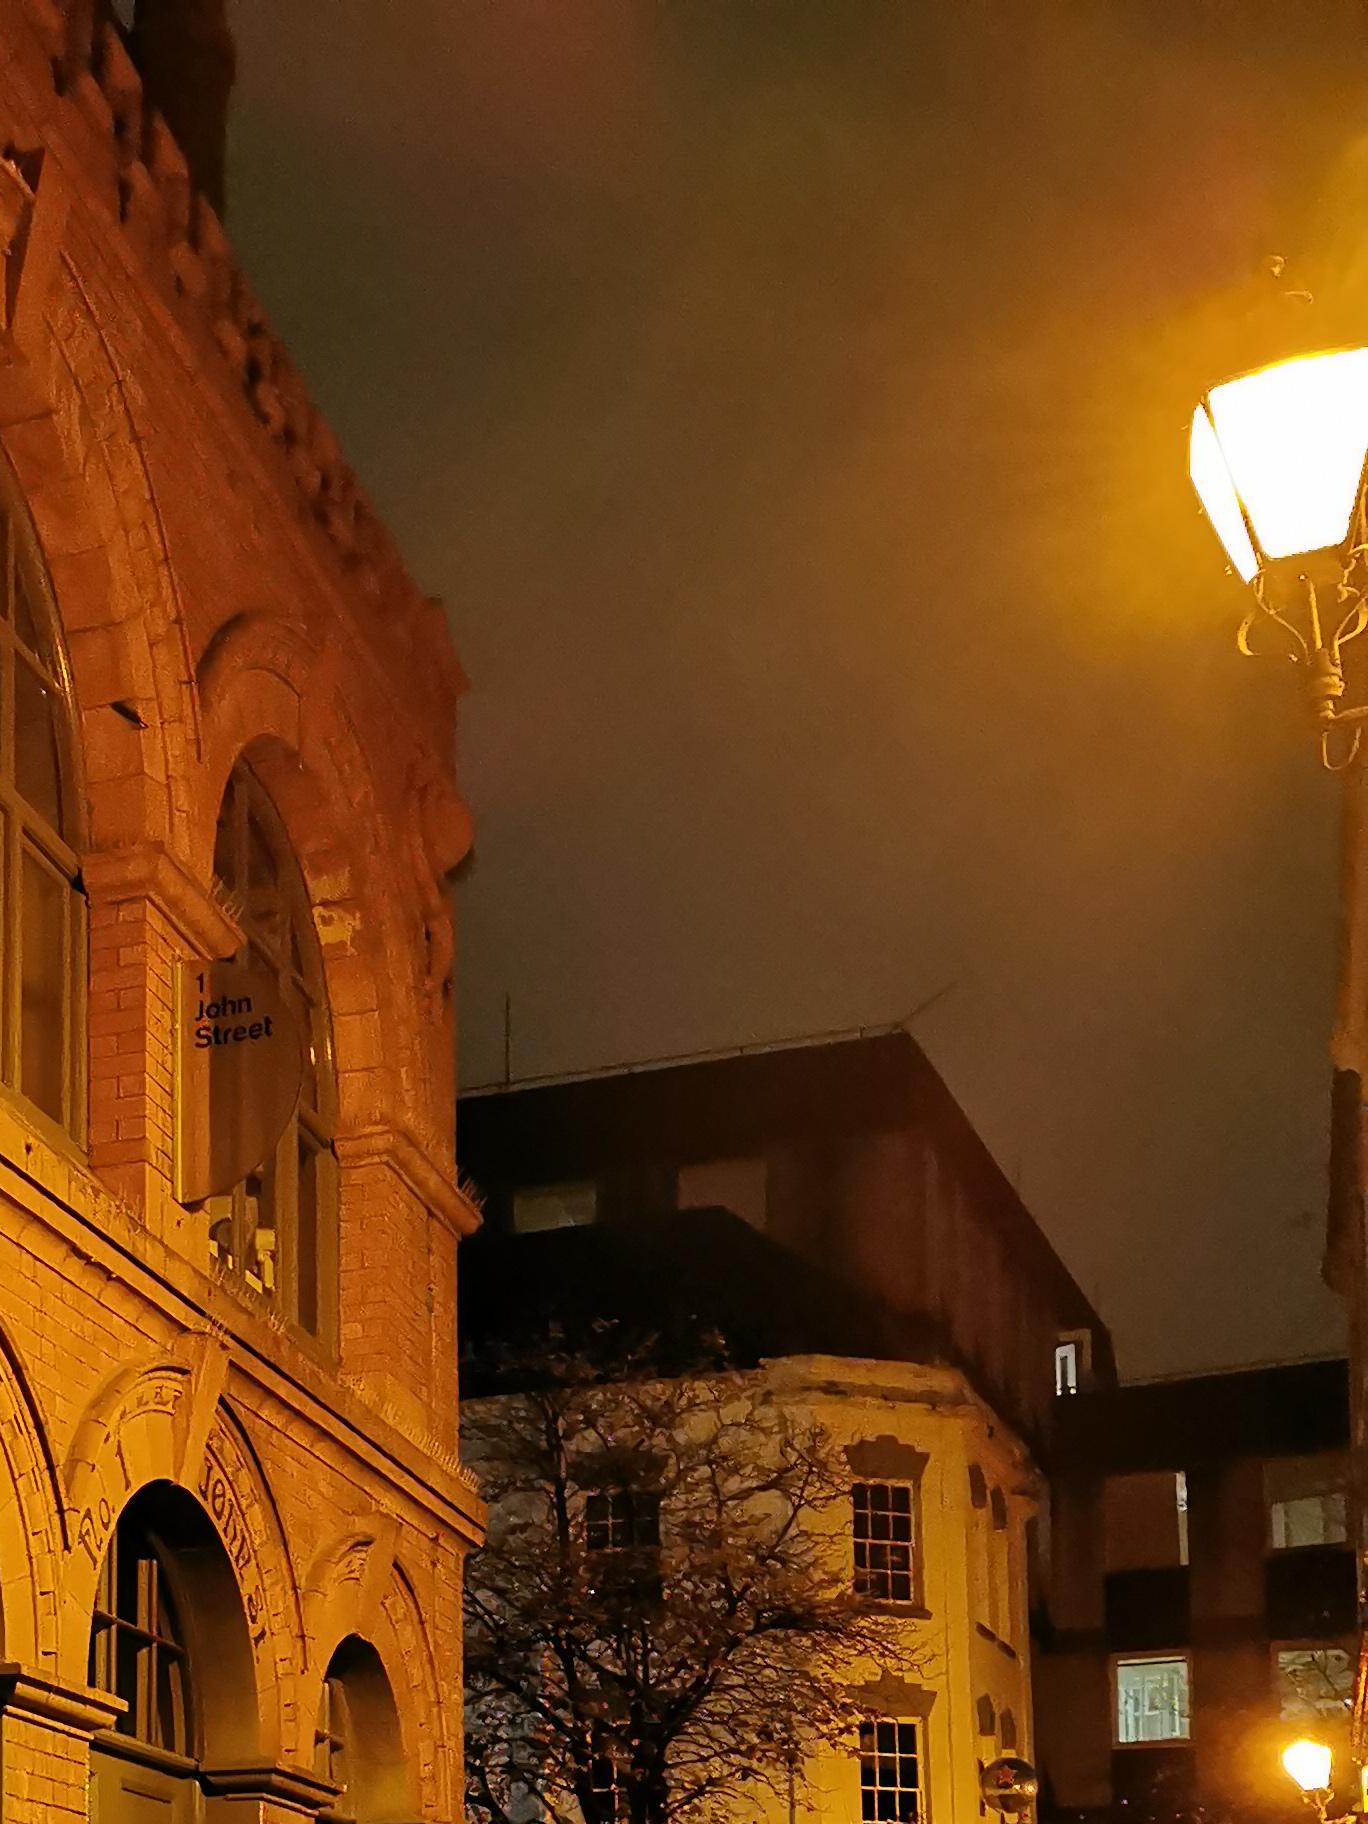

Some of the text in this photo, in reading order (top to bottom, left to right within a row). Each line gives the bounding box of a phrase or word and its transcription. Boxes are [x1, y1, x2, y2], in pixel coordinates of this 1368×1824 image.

[196, 972, 204, 993] 1
[195, 995, 252, 1022] John
[195, 1015, 273, 1048] Street
